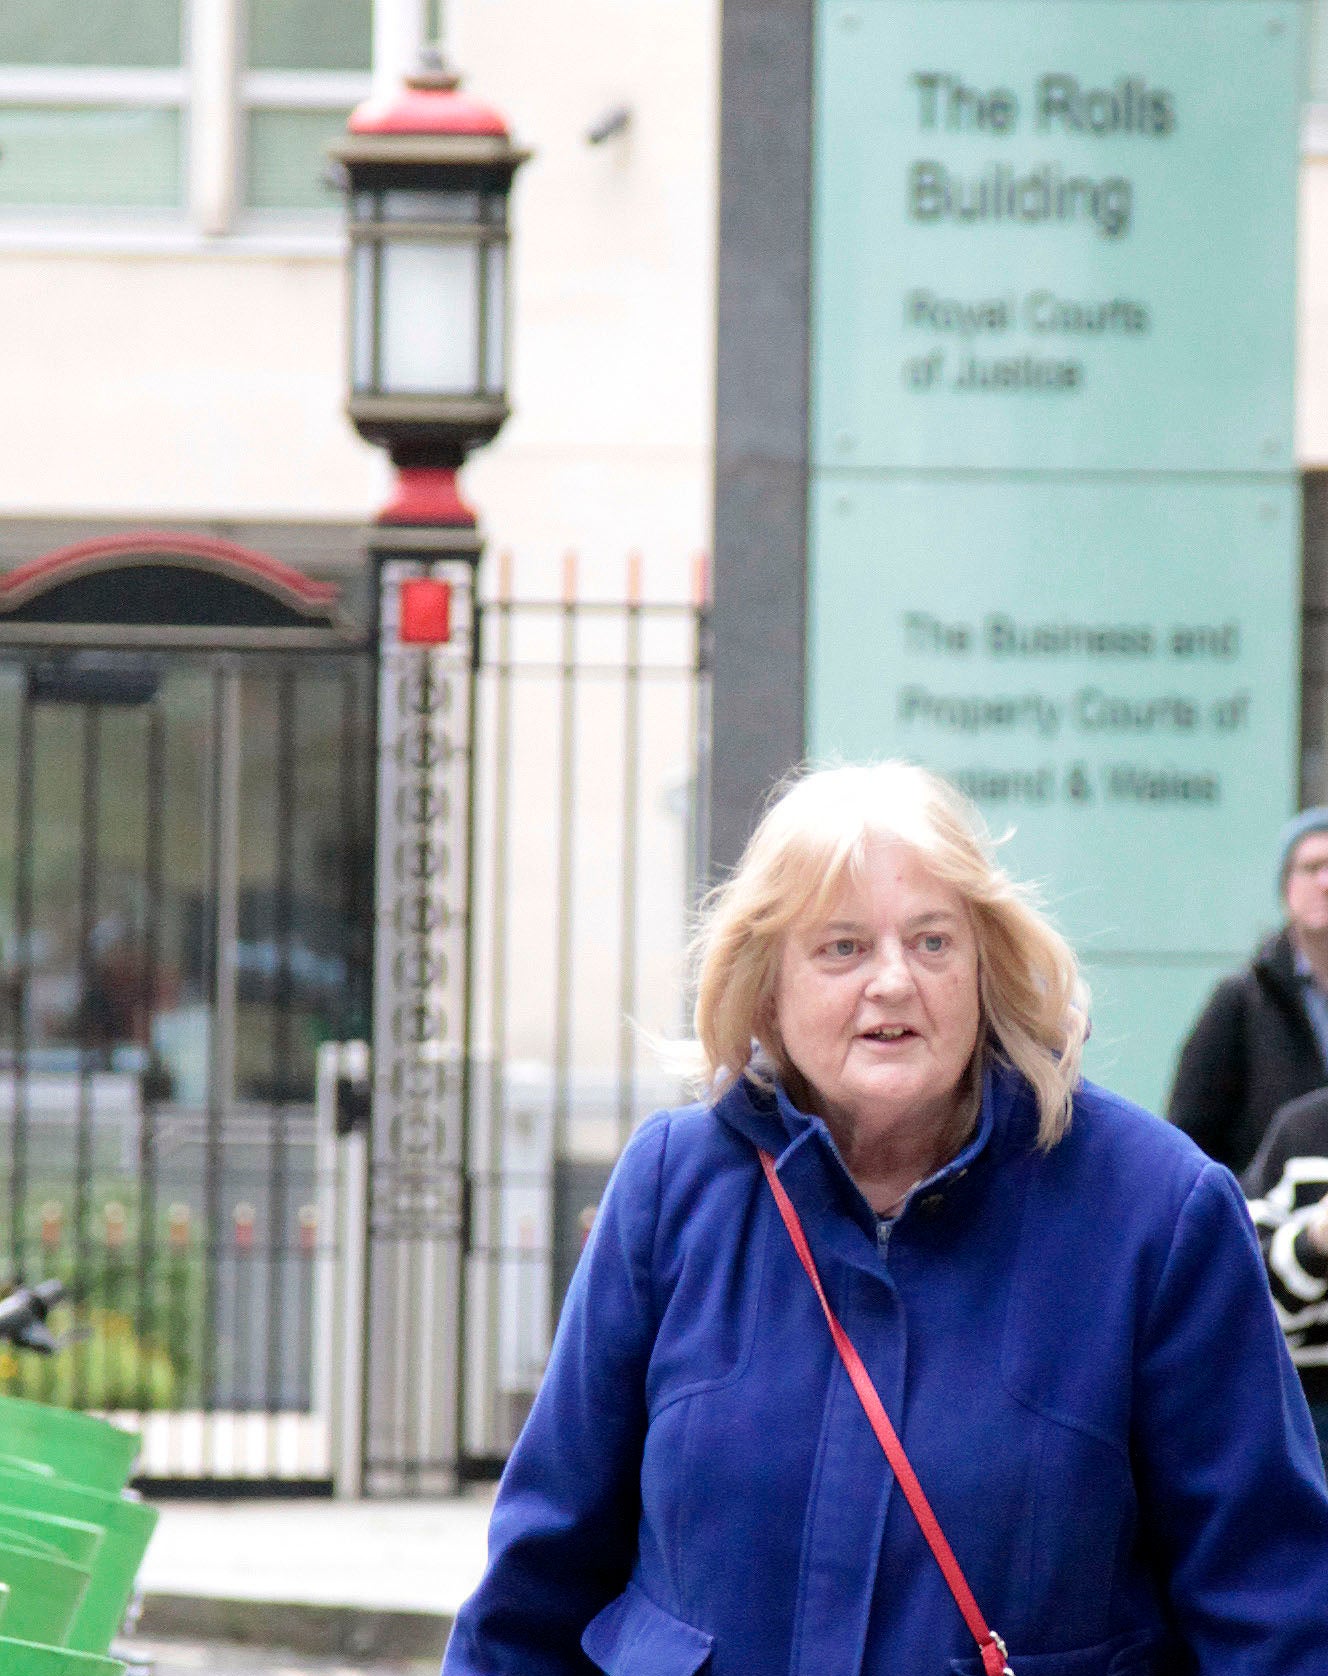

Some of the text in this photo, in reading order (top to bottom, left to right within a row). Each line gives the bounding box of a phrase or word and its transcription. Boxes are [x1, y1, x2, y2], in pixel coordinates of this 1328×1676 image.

[913, 71, 1177, 137] The Rolls
[909, 160, 1133, 241] Building
[906, 290, 1150, 337] Royal Courts
[905, 348, 1082, 392] of Justice
[903, 611, 971, 655] The
[983, 612, 1155, 657] Business
[1075, 687, 1198, 731] Courts
